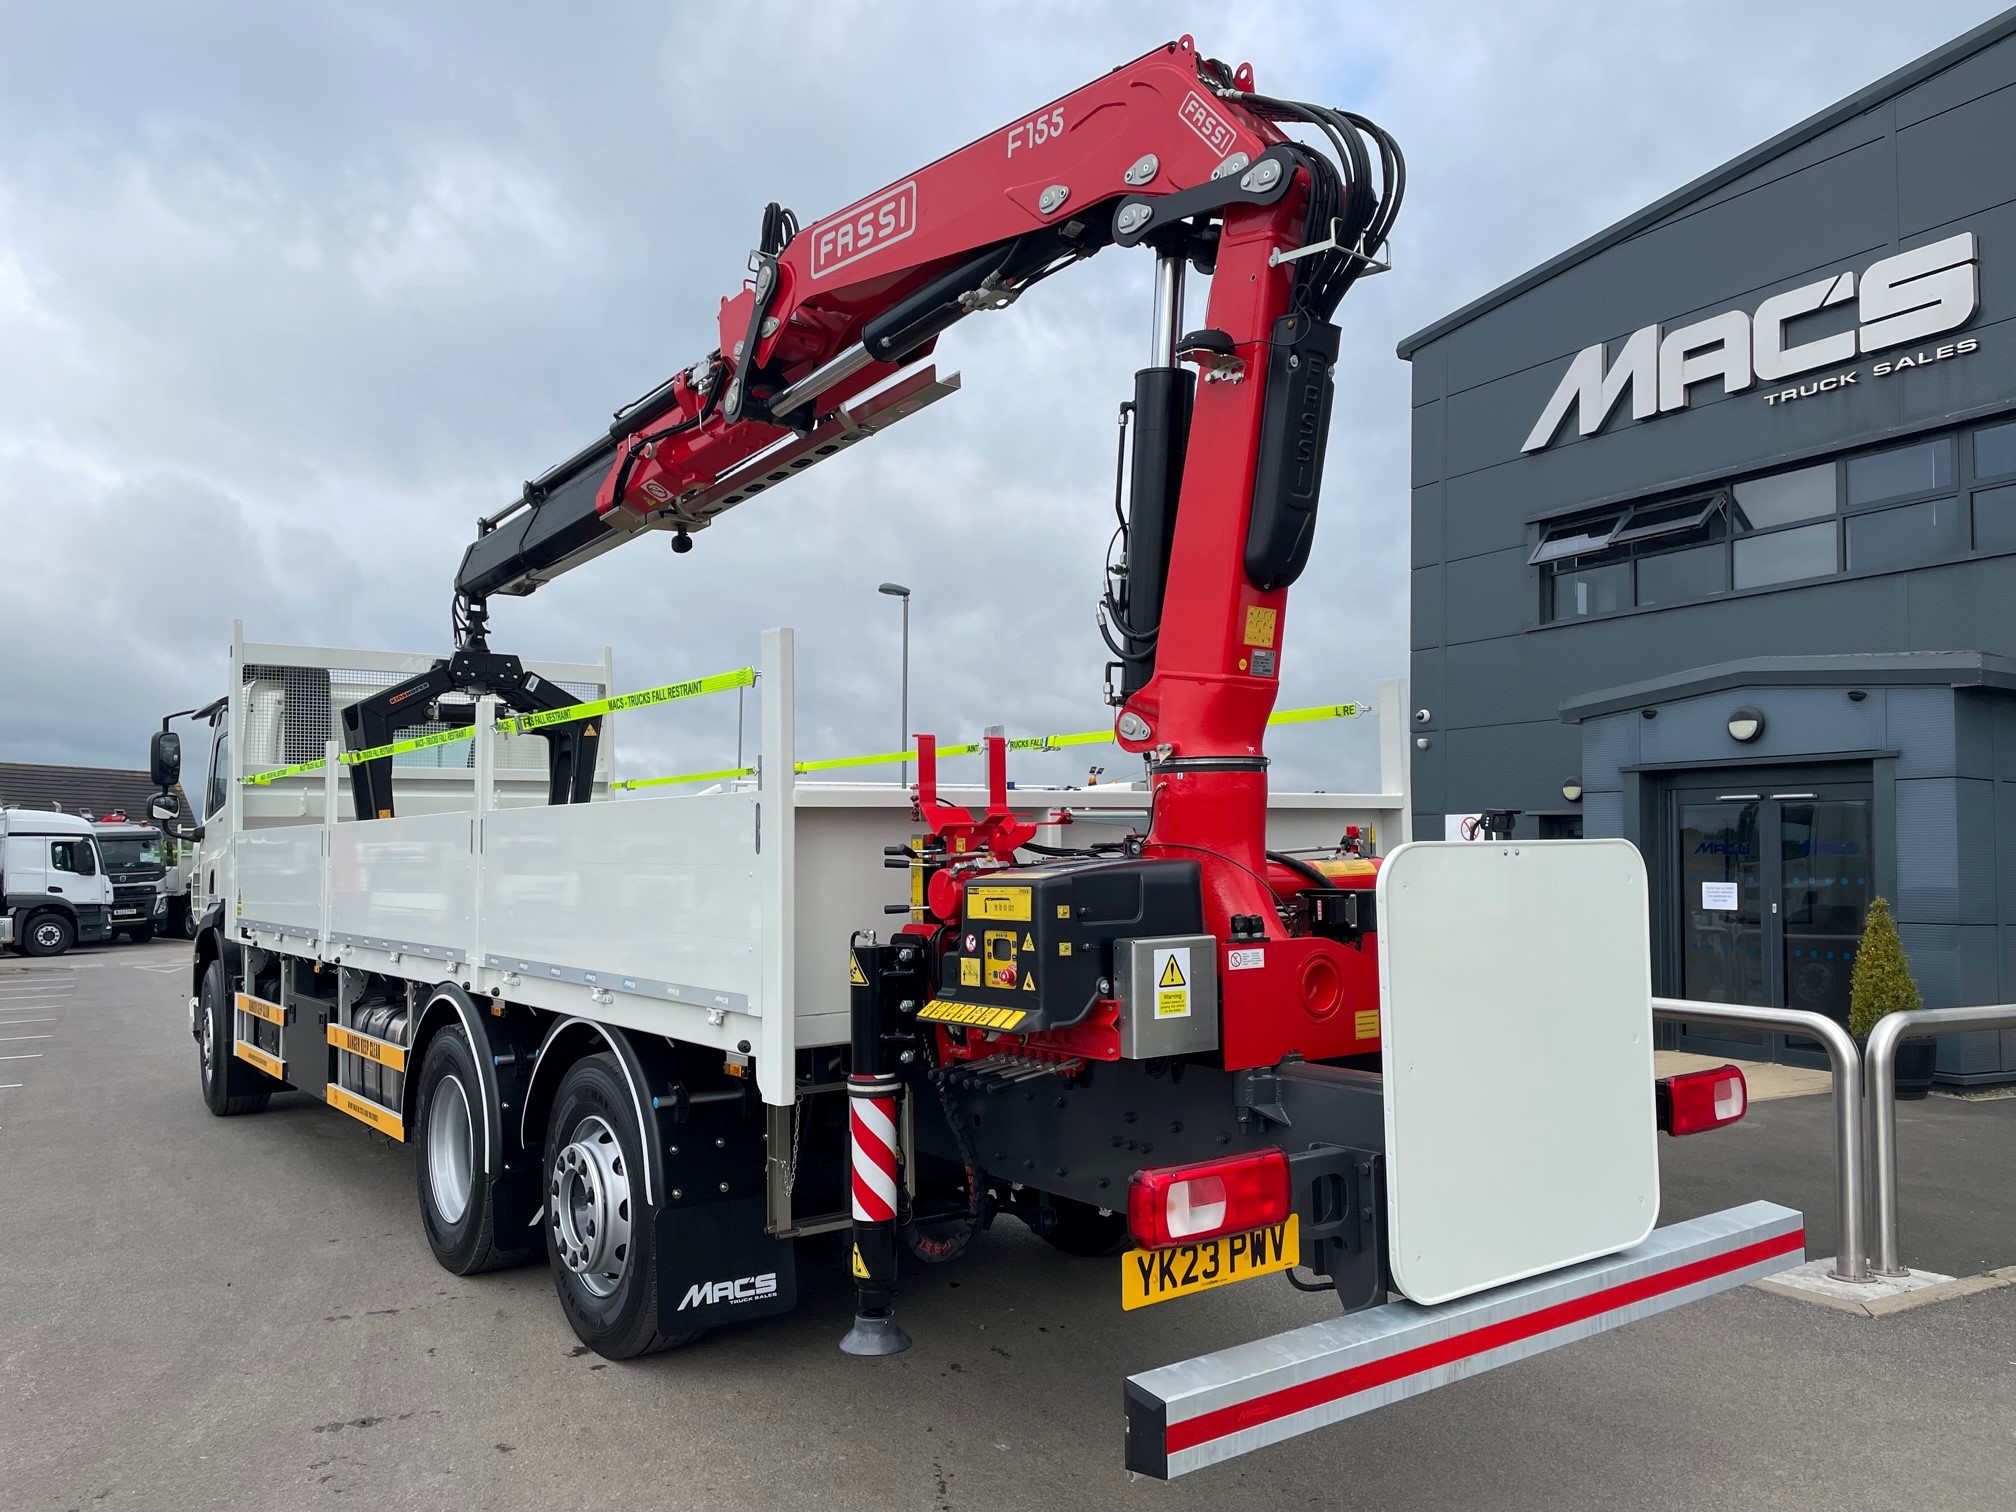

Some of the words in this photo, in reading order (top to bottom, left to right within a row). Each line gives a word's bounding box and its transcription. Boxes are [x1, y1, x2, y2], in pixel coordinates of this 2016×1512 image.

[1007, 106, 1065, 159] F155
[1184, 99, 1230, 149] FASSI
[820, 196, 906, 265] FASSI
[1763, 371, 1858, 406] TRUCK
[1872, 338, 1979, 377] SALES
[607, 696, 624, 711] MACS
[628, 691, 651, 708] TRUCKS
[651, 688, 667, 704] FALL
[667, 680, 703, 701] RESTRAINT
[535, 713, 546, 726] FALL
[546, 709, 571, 722] RESTRAINT
[448, 729, 467, 742] RESTRAINT
[1009, 739, 1029, 749] RUCKS
[360, 1037, 369, 1056] KEEP
[370, 1039, 381, 1060] CLEAR
[1137, 1241, 1220, 1296] YK23
[1230, 1222, 1285, 1273] PWV
[729, 1296, 754, 1305] TRUCK
[754, 1292, 778, 1300] SALES
